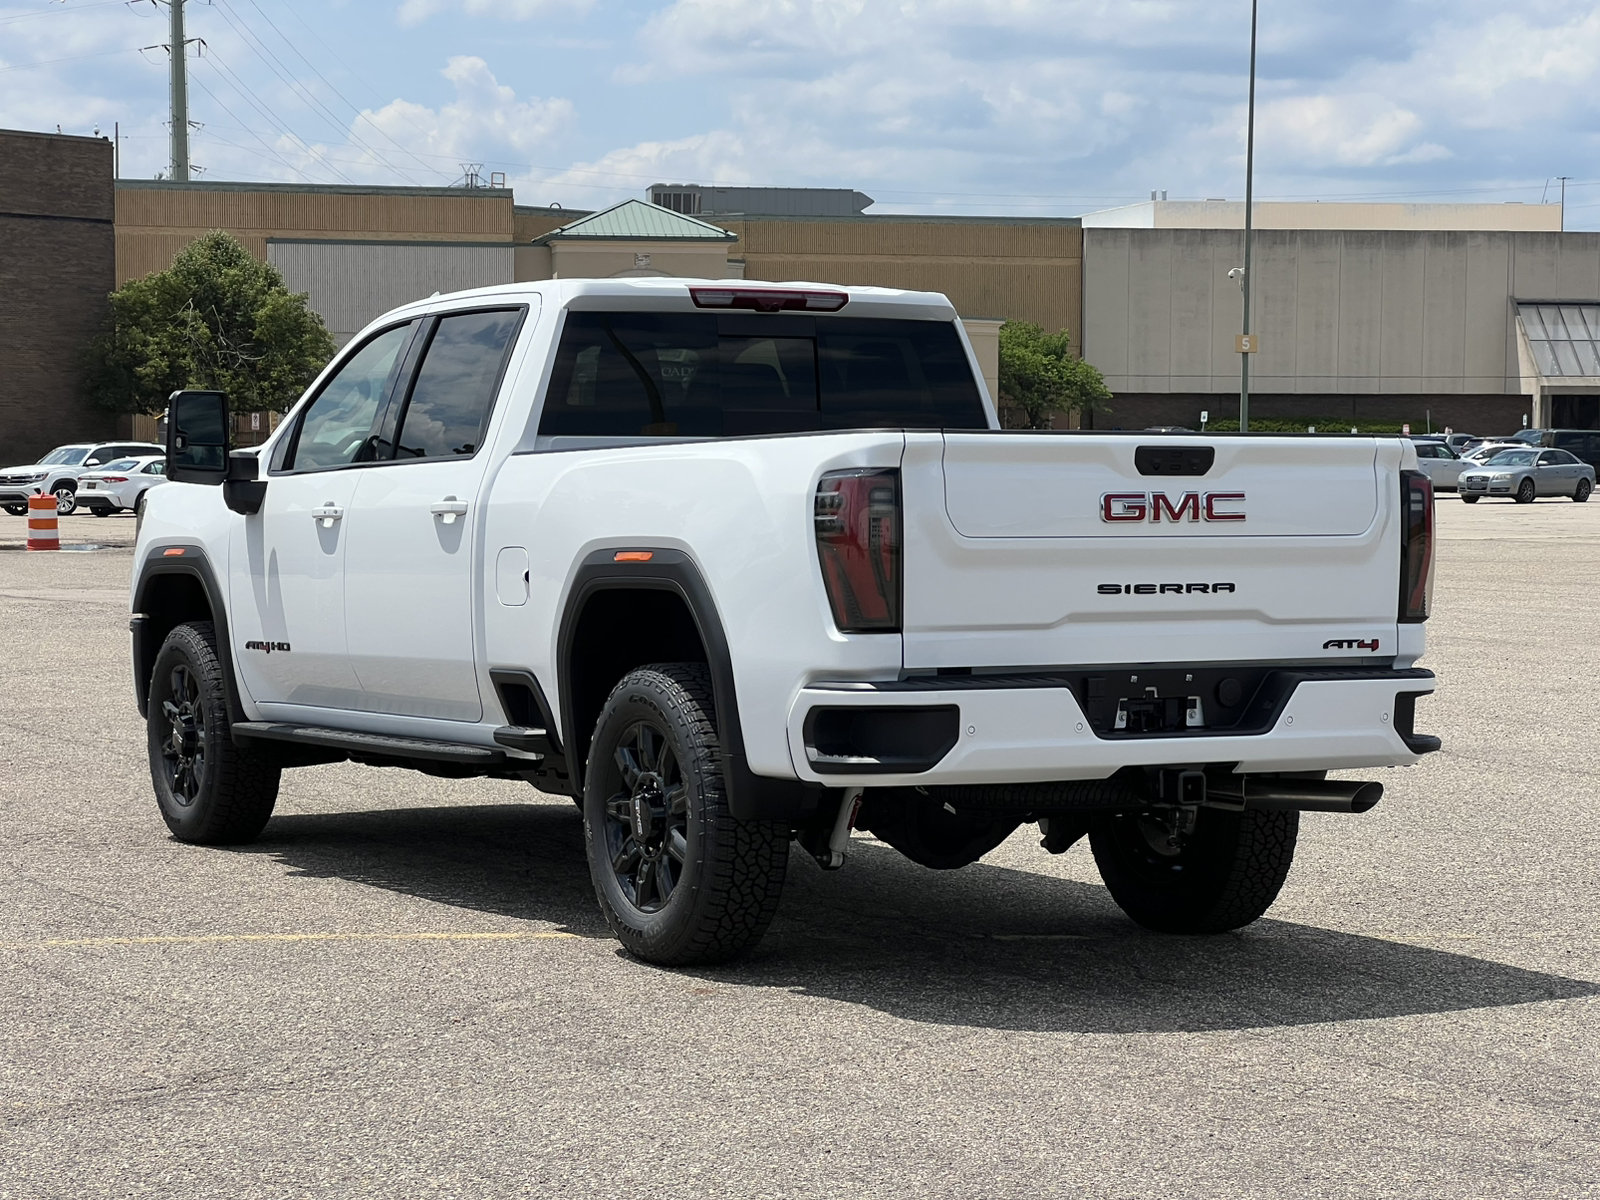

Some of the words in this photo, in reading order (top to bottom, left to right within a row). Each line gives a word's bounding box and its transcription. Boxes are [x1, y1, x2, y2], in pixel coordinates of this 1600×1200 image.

[1241, 337, 1250, 350] 5
[1100, 490, 1246, 523] GMC
[1097, 582, 1236, 595] SIERRA
[1322, 638, 1379, 652] AT4
